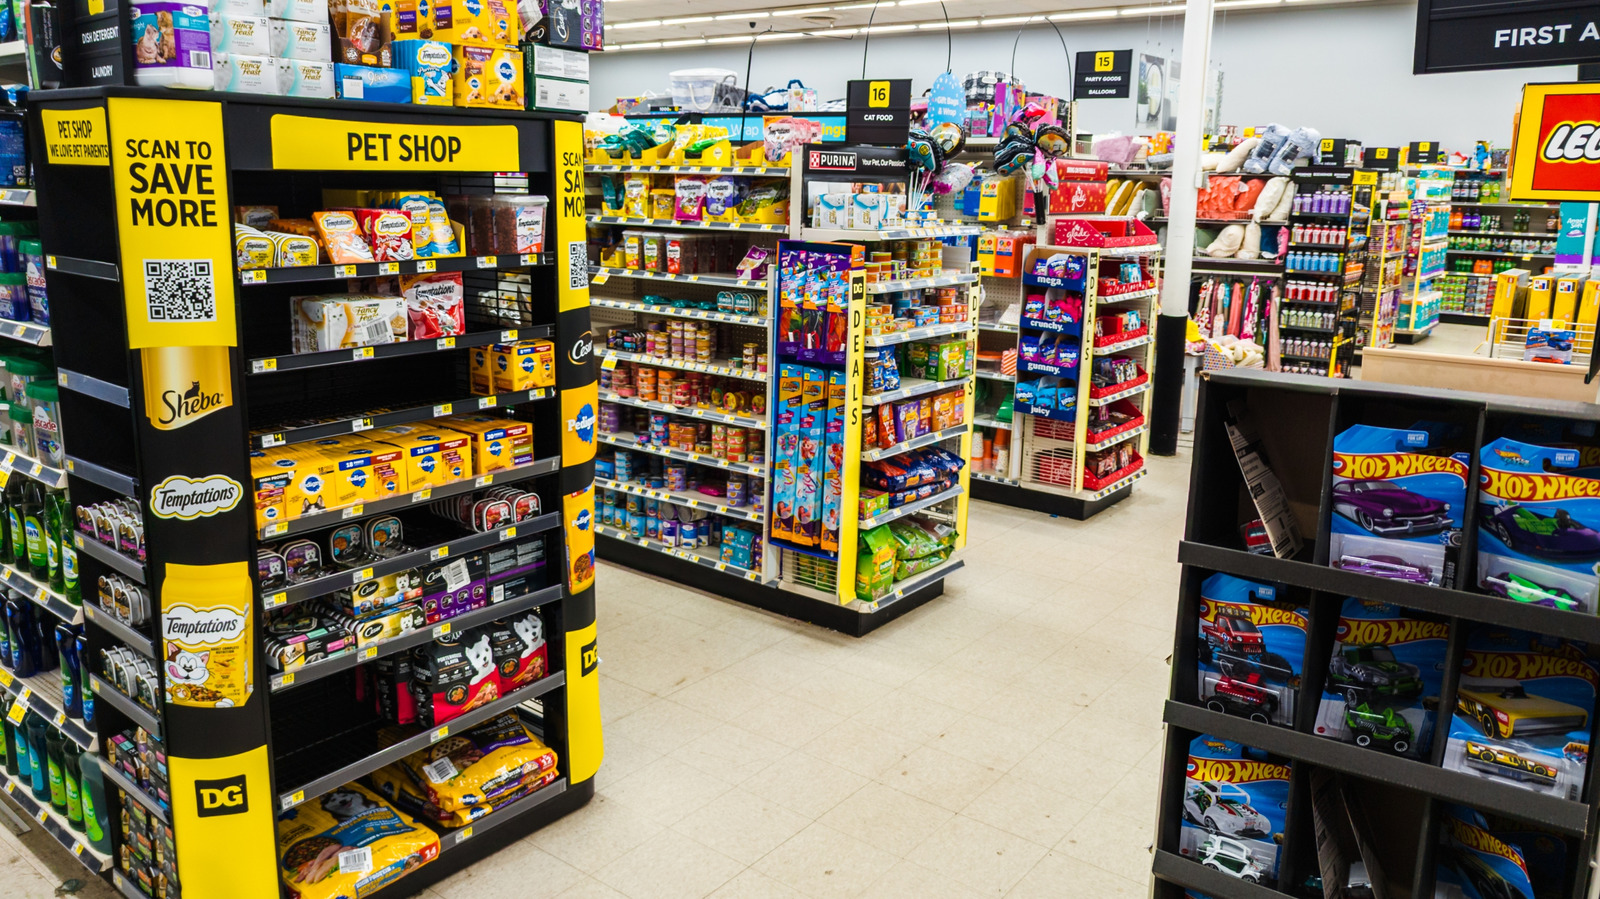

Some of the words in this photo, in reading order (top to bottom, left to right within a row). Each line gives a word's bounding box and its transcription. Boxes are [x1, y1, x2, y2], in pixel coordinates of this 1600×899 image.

[82, 32, 95, 44] DISH
[95, 25, 119, 43] DETERGENT
[1494, 24, 1572, 49] FIRST
[1098, 56, 1110, 67] 15
[92, 64, 113, 79] LAUNDRY
[872, 88, 886, 101] 16
[876, 114, 894, 122] FOOD
[943, 107, 957, 117] Wrap
[58, 121, 72, 139] PET
[72, 120, 93, 139] SHOP
[730, 123, 759, 136] Wrap
[50, 144, 59, 157] WE
[59, 144, 73, 158] LOVE
[73, 144, 84, 158] PET
[84, 144, 109, 159] PARENTS
[126, 139, 179, 159] SCAN
[186, 141, 212, 160] TO
[347, 132, 392, 161] PET
[399, 134, 461, 162] SHOP
[820, 154, 855, 167] PURINA
[862, 158, 872, 166] Your
[881, 159, 889, 167] Our
[129, 162, 215, 195] SAVE
[130, 198, 218, 227] MORE
[1567, 217, 1586, 226] Angel
[1066, 229, 1090, 244] glade
[853, 283, 863, 294] DG
[1037, 276, 1064, 287] mega.
[1084, 276, 1095, 361] DEALS
[1030, 320, 1064, 332] crunchy.
[851, 310, 861, 426] DEALS
[1027, 362, 1061, 375] gummy.
[158, 389, 222, 425] Sheba
[1030, 405, 1051, 417] juicy
[159, 487, 235, 511] Temptations
[166, 616, 238, 637] Temptations
[437, 652, 463, 663] PORTERHOUSE
[444, 658, 460, 666] FLAVOR
[541, 756, 553, 766] 12
[200, 784, 244, 809] DG
[424, 846, 437, 859] 14
